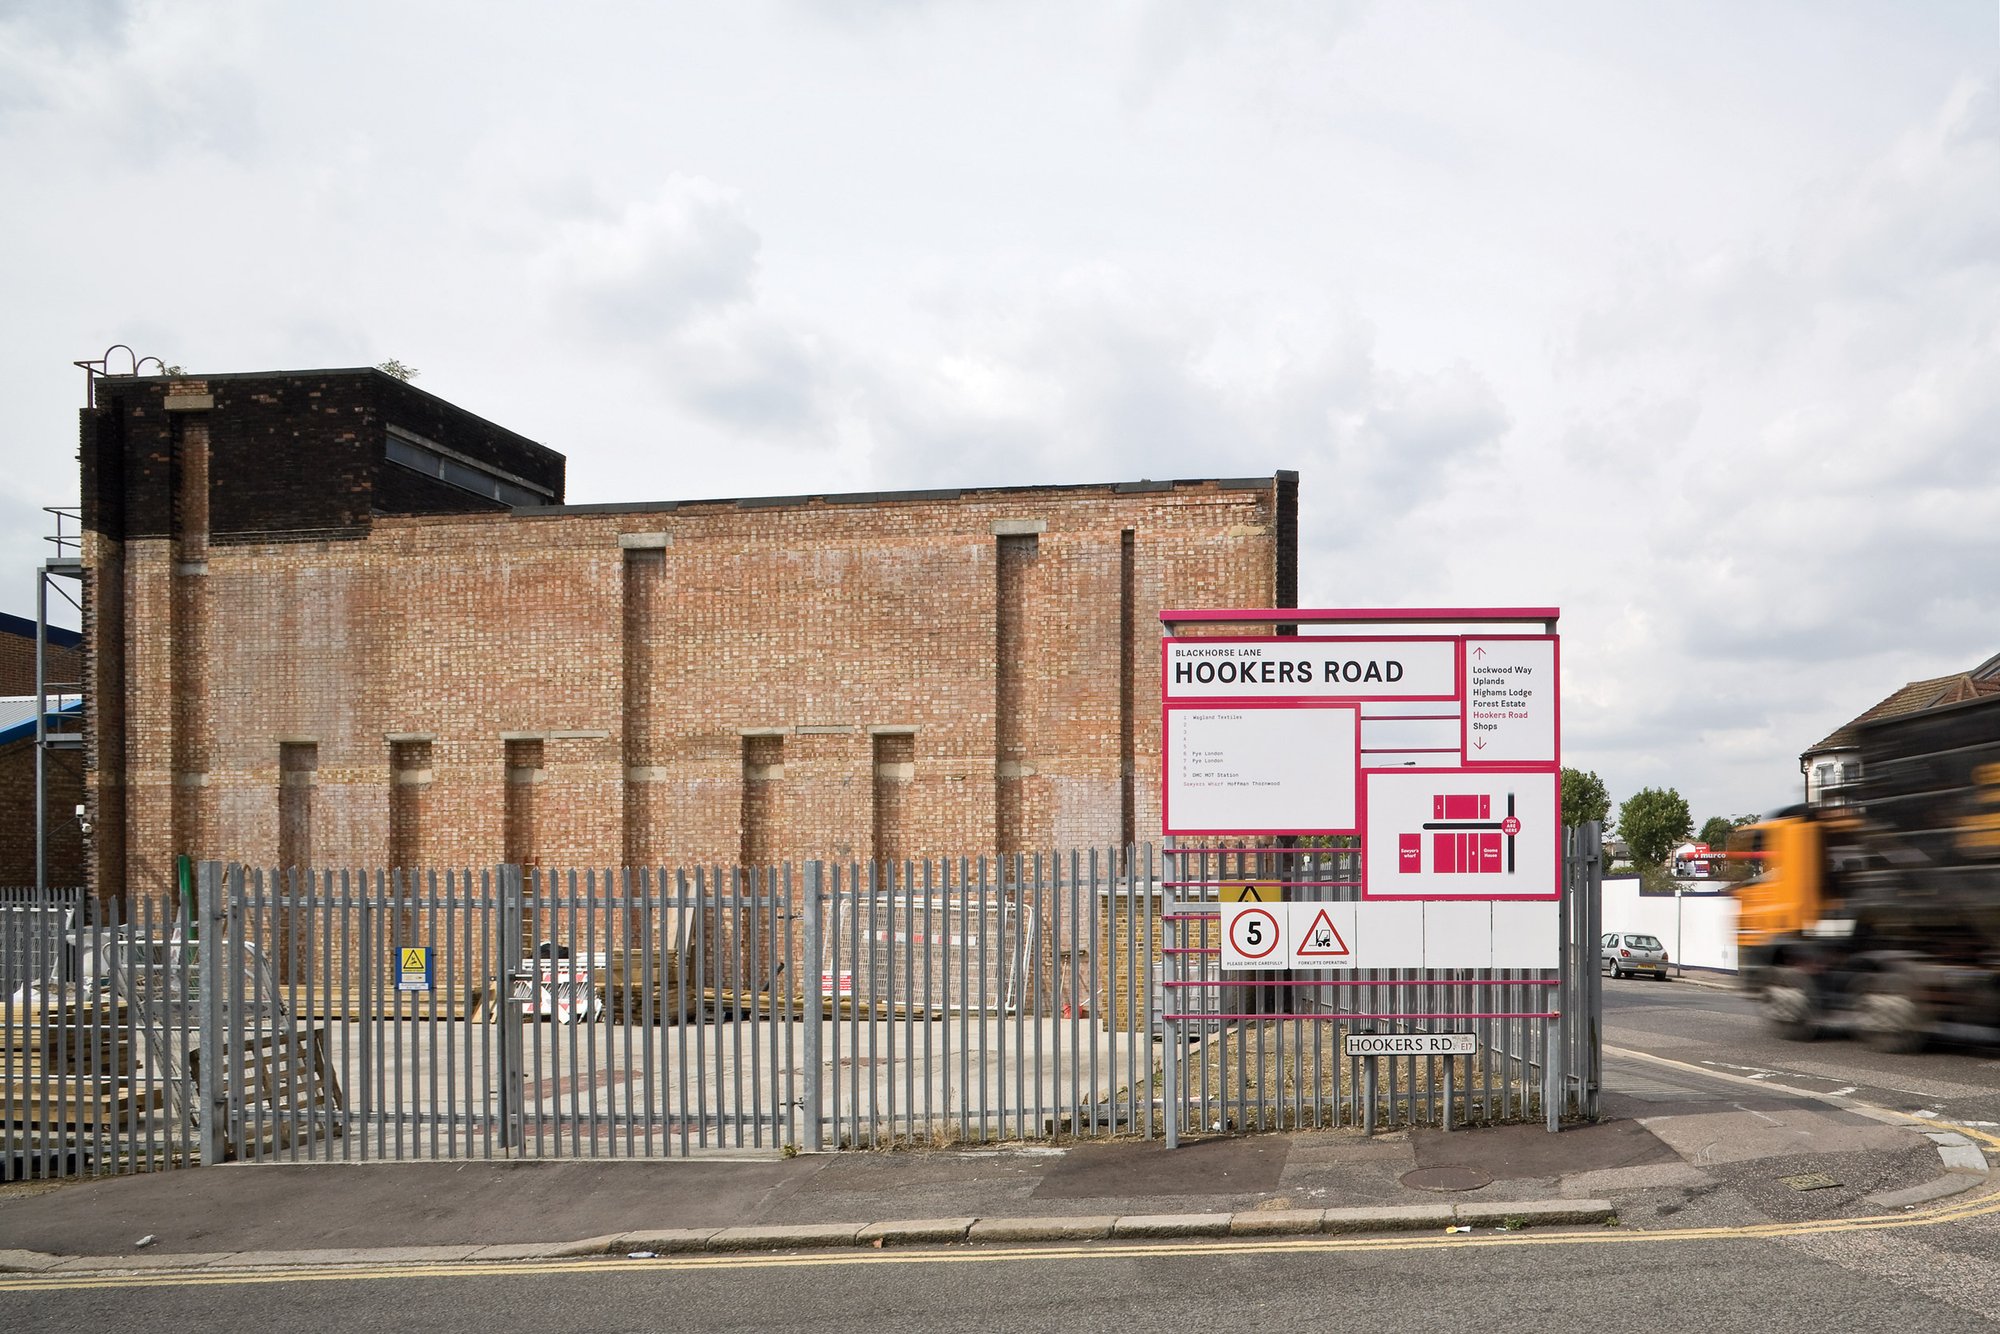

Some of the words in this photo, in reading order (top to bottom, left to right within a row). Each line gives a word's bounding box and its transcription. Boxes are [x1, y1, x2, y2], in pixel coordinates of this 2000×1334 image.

[1175, 649, 1235, 657] BLACKHORSE
[1175, 661, 1313, 684] HOOKERS
[1324, 660, 1404, 683] ROAD
[1514, 666, 1532, 675] Way
[1473, 677, 1505, 686] Uplands
[1473, 688, 1507, 697] Highams
[1509, 688, 1532, 697] Lodge
[1473, 711, 1506, 719] Hookers
[1473, 722, 1498, 731] Shops
[1247, 921, 1262, 945] 5
[1350, 1039, 1423, 1051] HOOKERS
